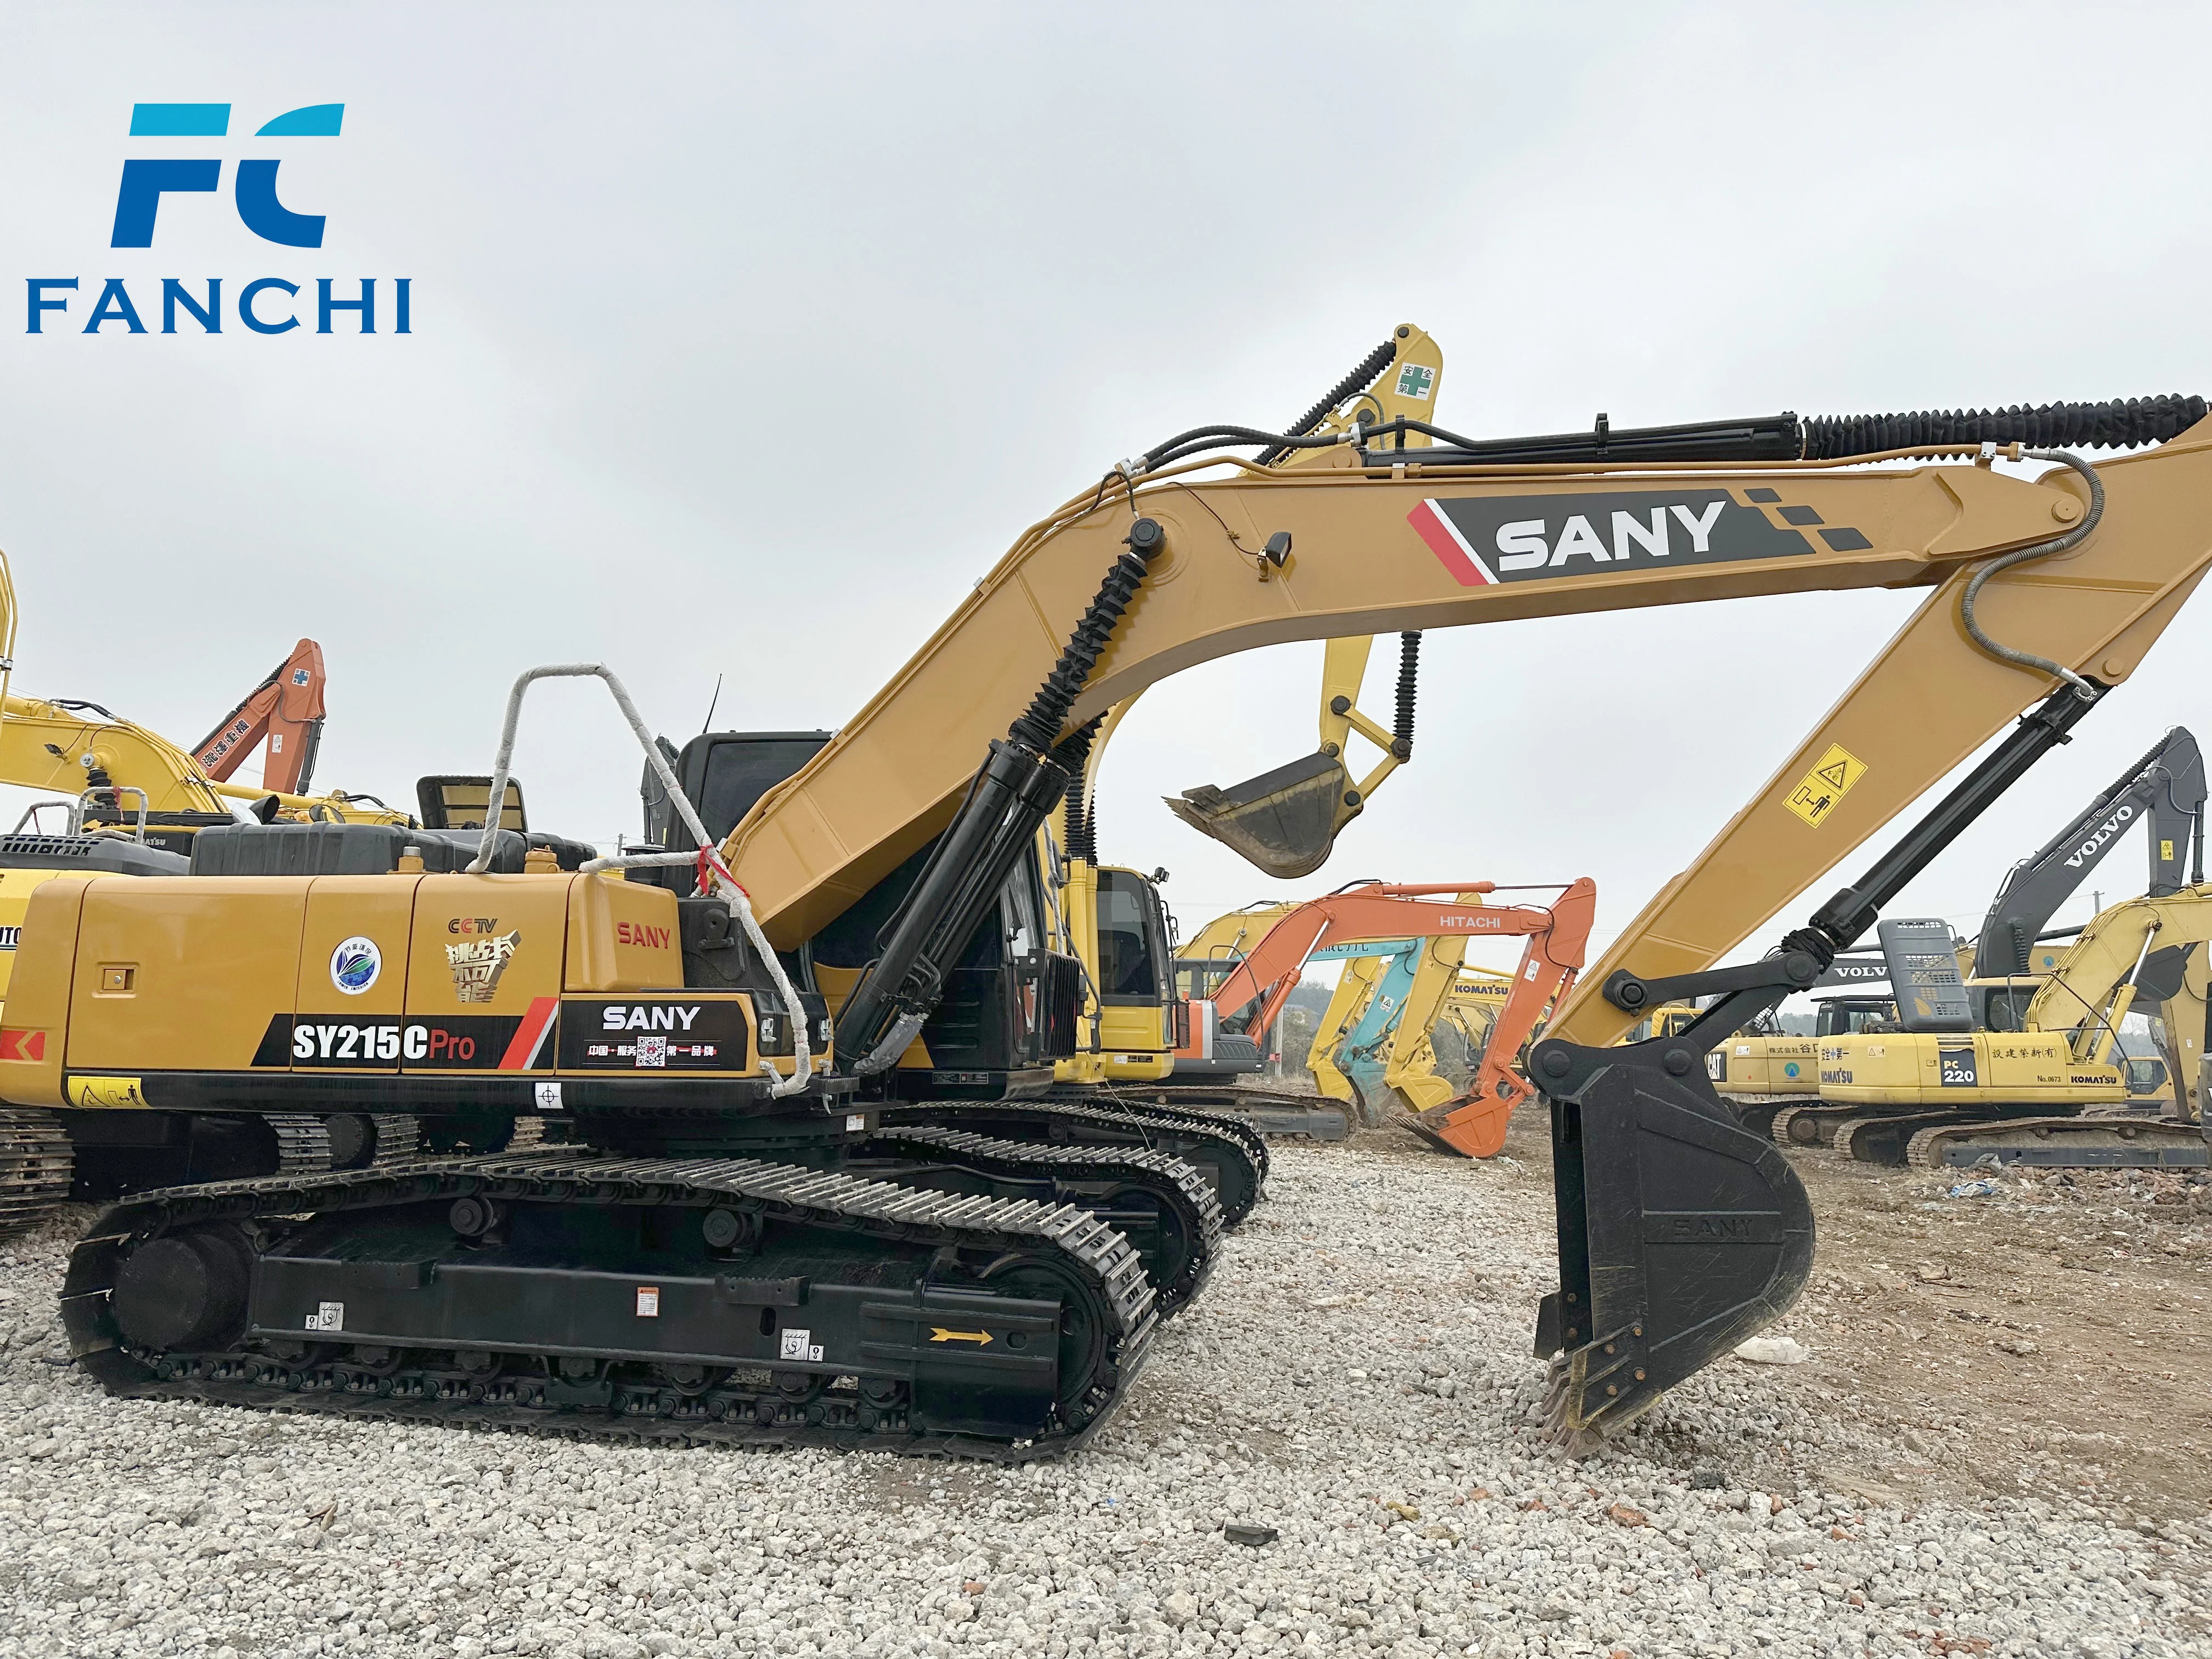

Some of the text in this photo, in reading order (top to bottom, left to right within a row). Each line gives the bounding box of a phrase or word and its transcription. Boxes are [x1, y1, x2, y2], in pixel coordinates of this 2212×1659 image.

[1403, 366, 1432, 379] 安全
[1397, 384, 1426, 394] 第一
[1496, 501, 1727, 572] SANY
[2063, 805, 2132, 868] VOLVO
[448, 918, 498, 934] CCTV
[1440, 916, 1500, 928] HITACHI
[617, 921, 670, 949] SANY
[1835, 966, 1888, 978] VOLV
[1455, 984, 1509, 995] KOMATSU
[603, 1006, 701, 1030] SANY
[666, 1045, 714, 1057] 第一品牌
[1708, 1054, 1721, 1079] CAT
[1944, 1060, 1958, 1069] PC
[1820, 1068, 1853, 1084] KOMATSU
[1944, 1070, 1974, 1082] 220
[2071, 1075, 2117, 1084] KOMATSU
[1673, 1218, 1754, 1238] SANY
